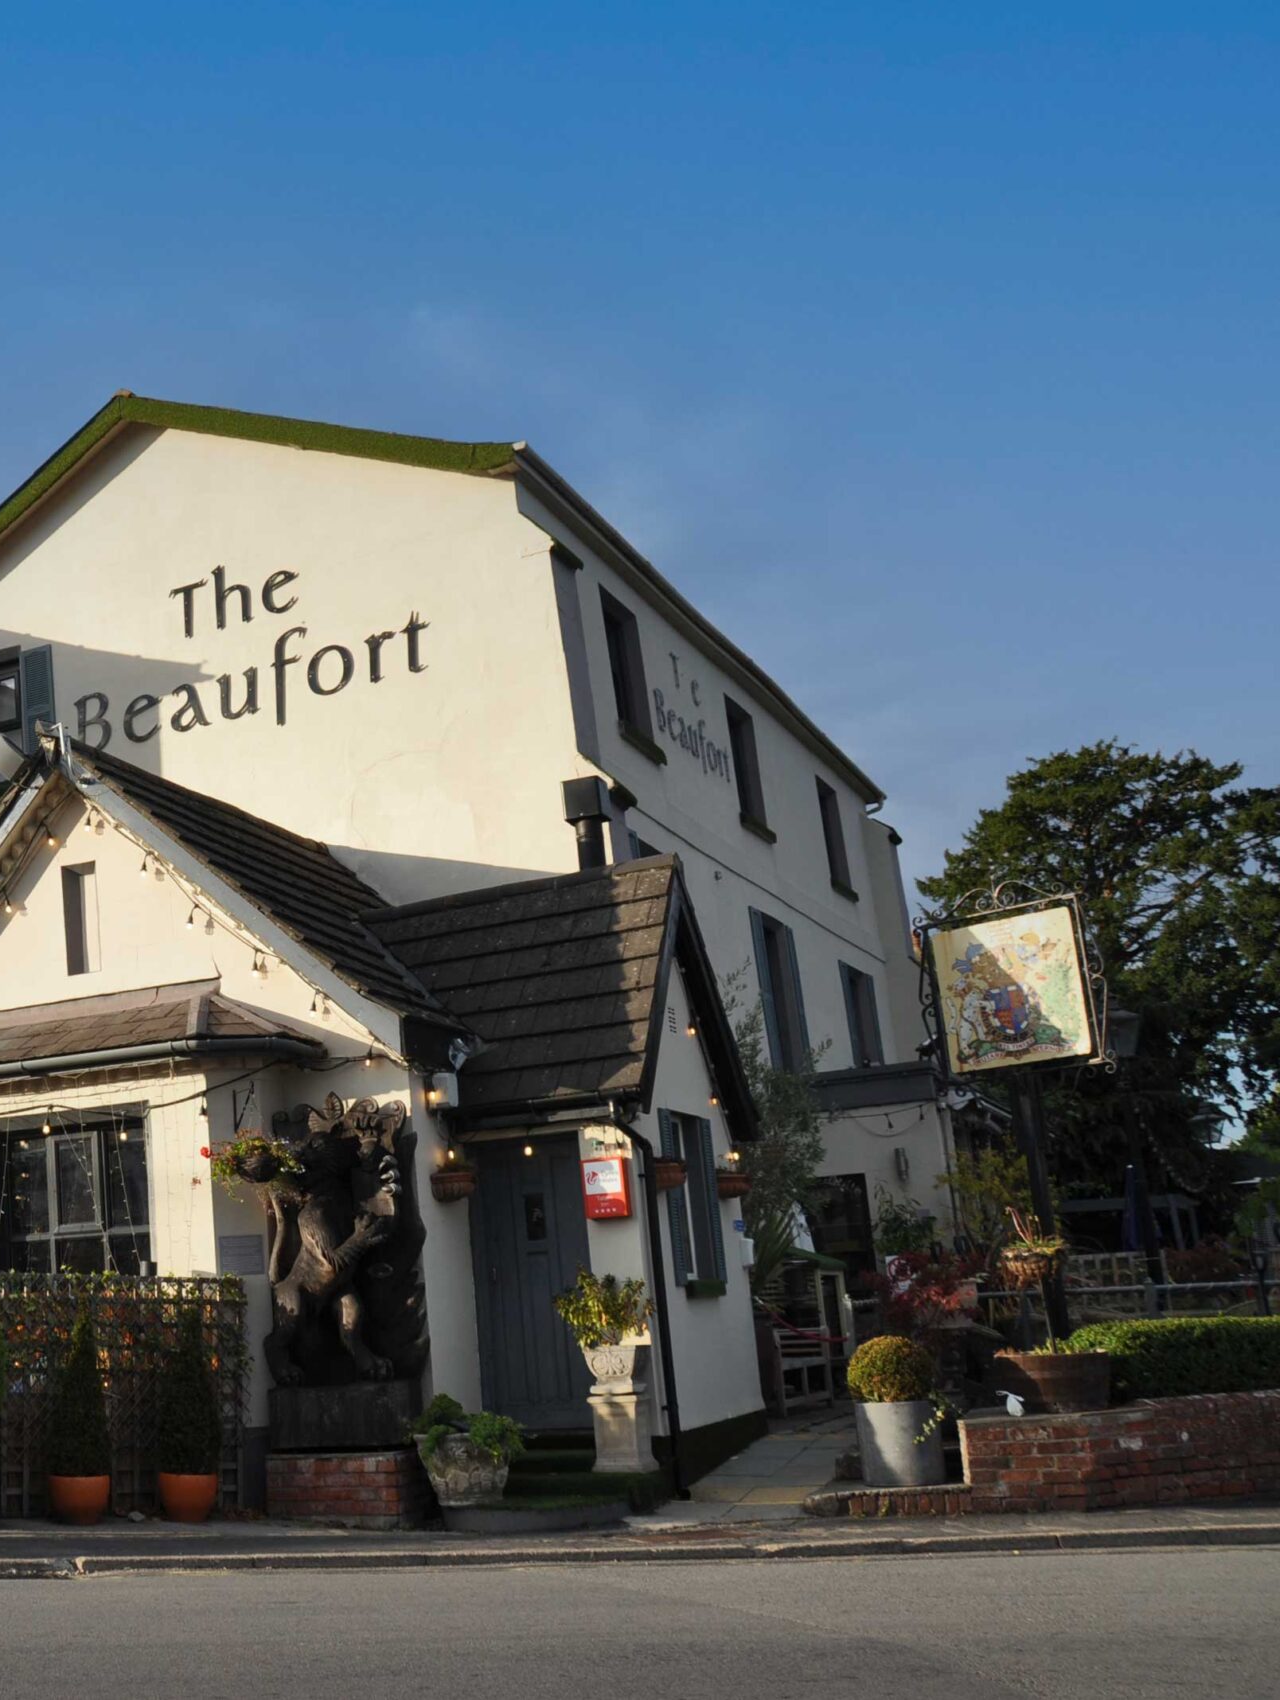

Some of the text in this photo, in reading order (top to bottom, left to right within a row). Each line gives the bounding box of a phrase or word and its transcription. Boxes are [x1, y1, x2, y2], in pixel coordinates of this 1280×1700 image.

[168, 564, 301, 639] The
[73, 610, 431, 752] Beaufort
[653, 687, 731, 783] Beaufort
